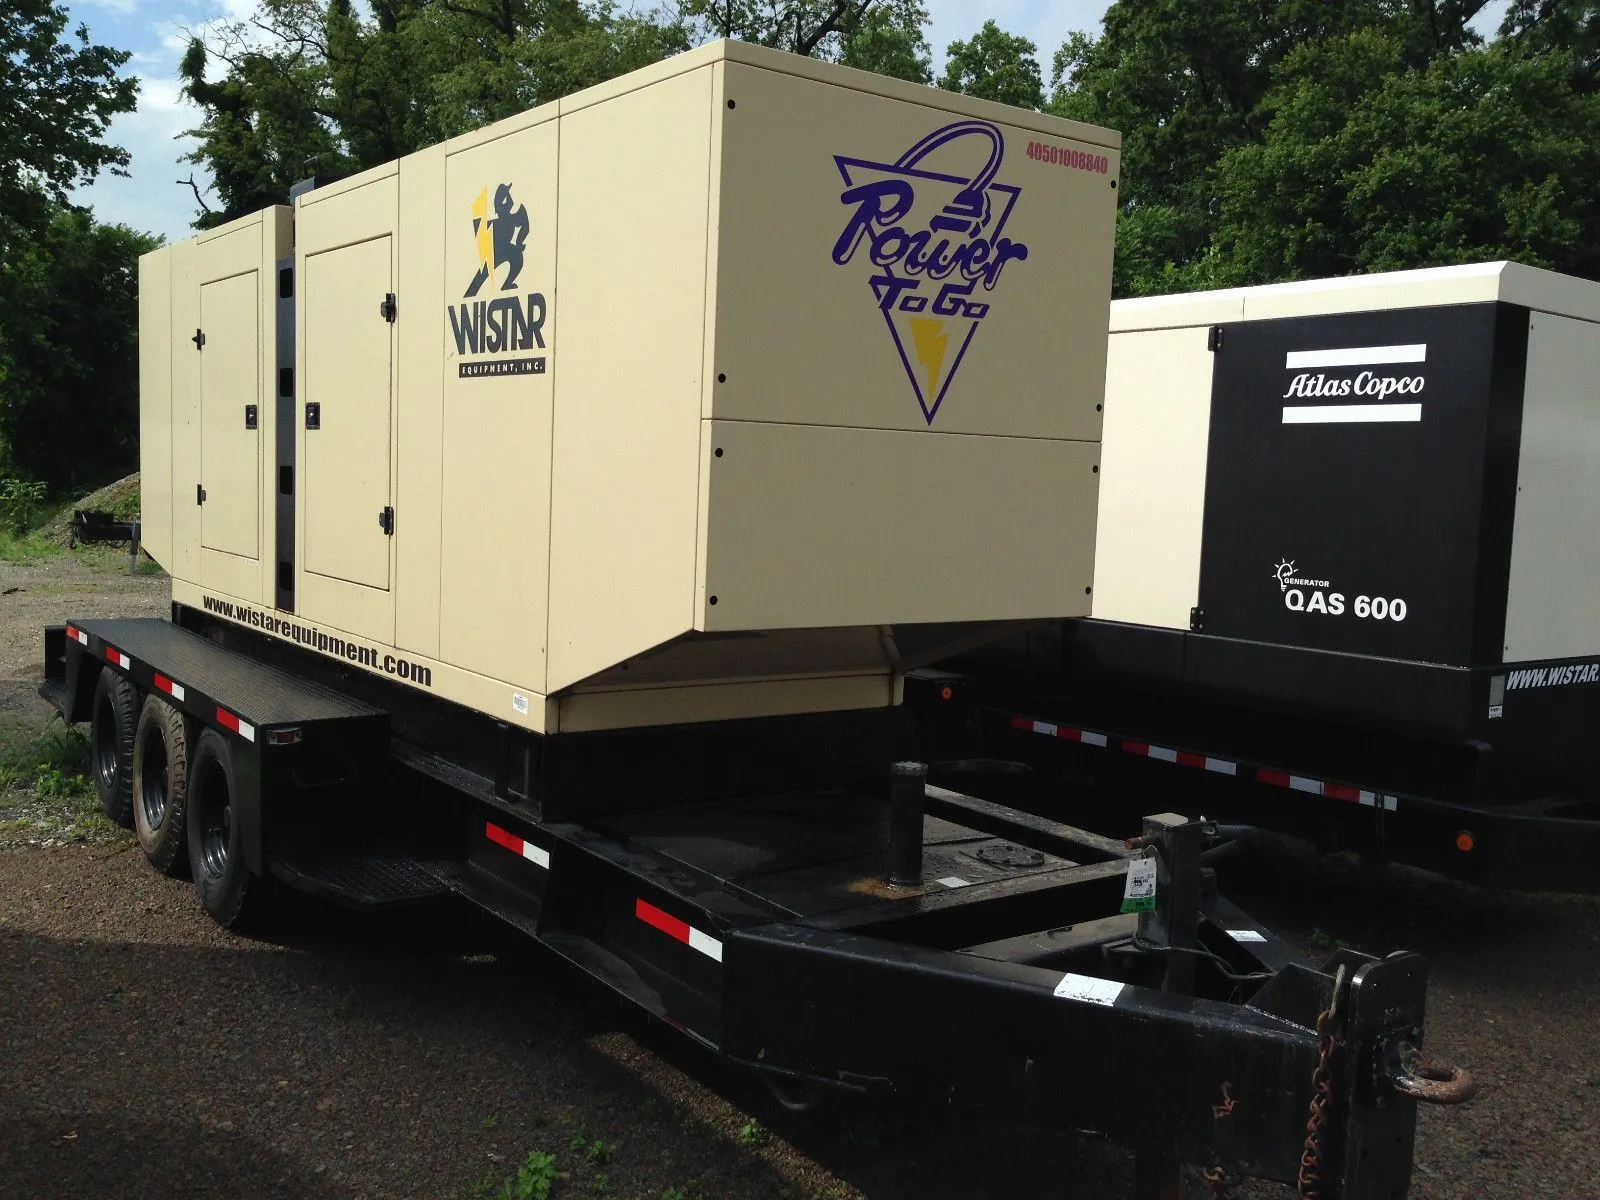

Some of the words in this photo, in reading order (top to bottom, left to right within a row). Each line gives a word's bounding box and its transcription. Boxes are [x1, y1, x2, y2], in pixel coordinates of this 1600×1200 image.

[1026, 141, 1108, 174] 40501008840
[832, 179, 1028, 291] Power
[868, 275, 928, 313] To
[932, 283, 990, 318] Go
[447, 292, 547, 355] WISTAR
[462, 363, 518, 375] EQUIPMENT,
[521, 361, 543, 371] INC.
[1283, 373, 1351, 398] Atlas
[1353, 371, 1425, 399] Copco
[1284, 577, 1330, 587] GENERATOR
[1285, 589, 1345, 615] QAS
[1354, 595, 1407, 621] 600
[202, 595, 432, 687] www.wistarequipment.com
